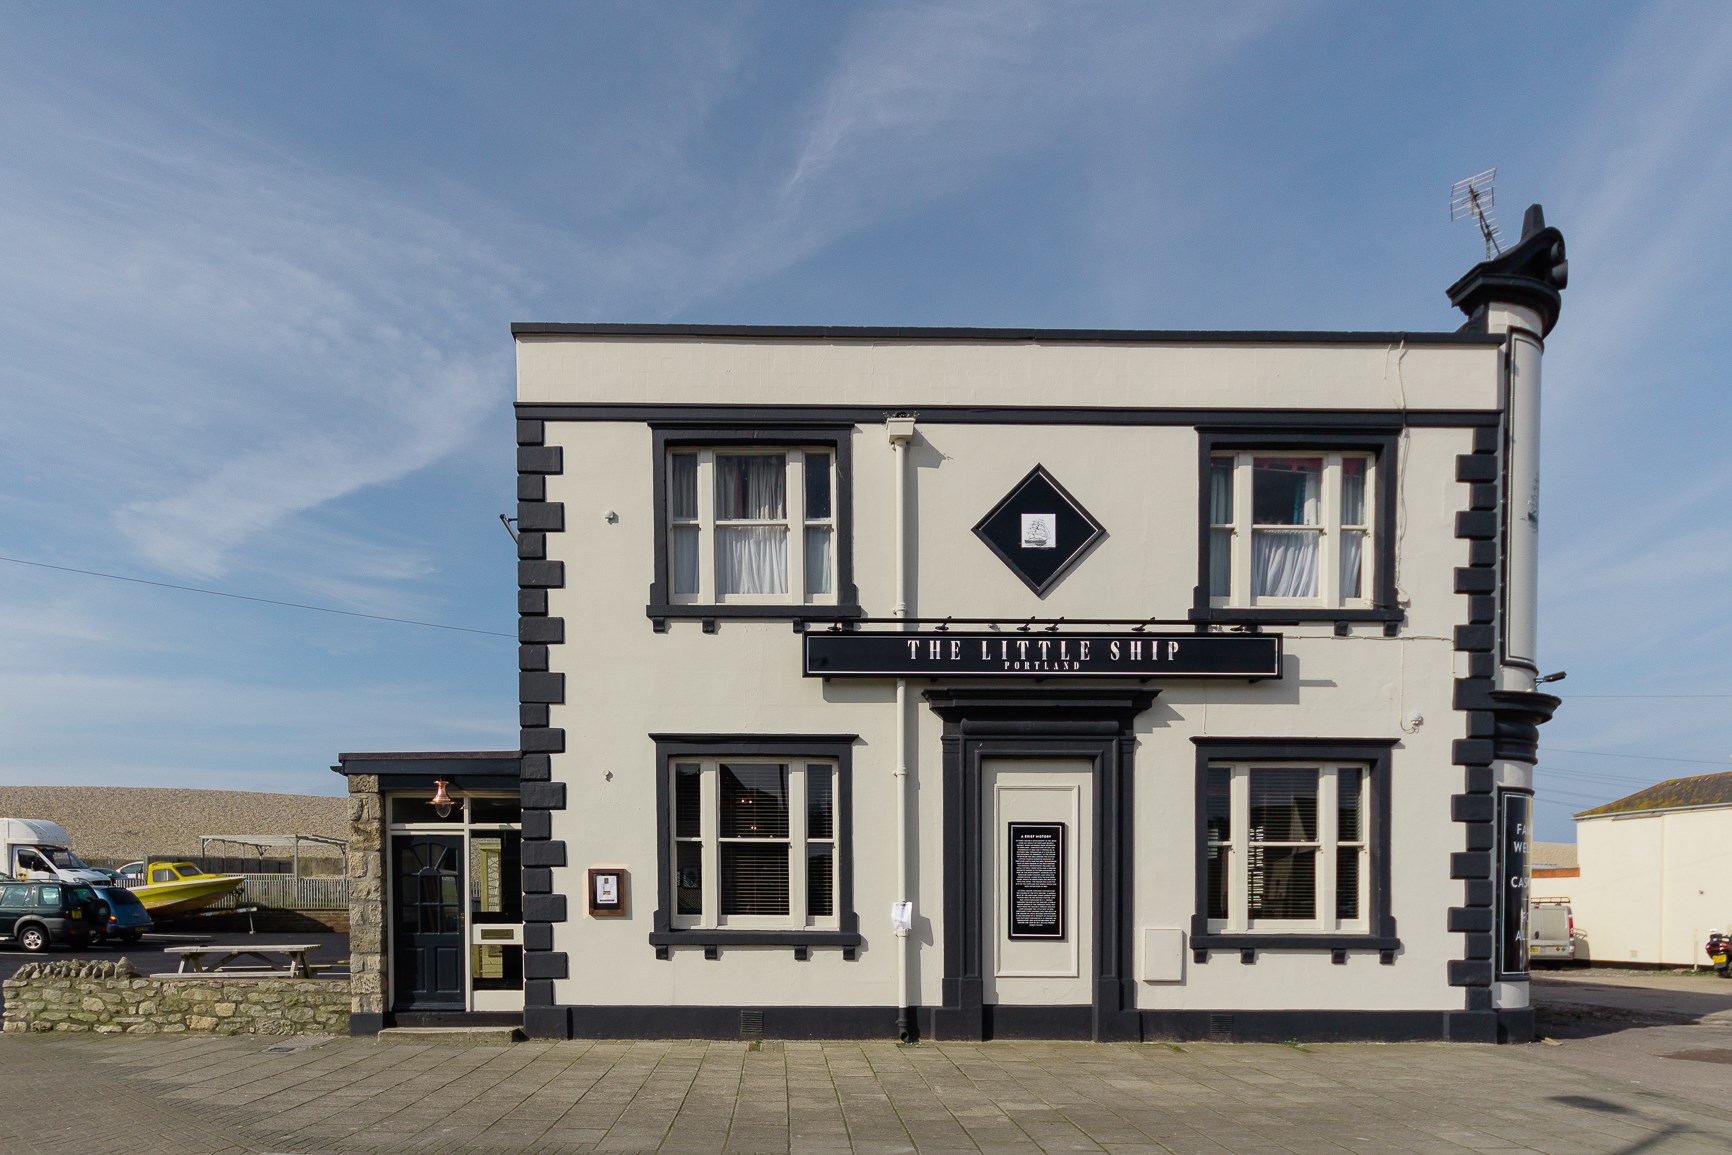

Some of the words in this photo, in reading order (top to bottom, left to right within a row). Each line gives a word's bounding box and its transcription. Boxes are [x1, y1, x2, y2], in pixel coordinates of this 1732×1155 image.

[907, 640, 961, 660] THE
[981, 640, 1090, 660] LITTLE
[1110, 640, 1179, 660] SHIP
[1004, 661, 1080, 670] PORTLAND
